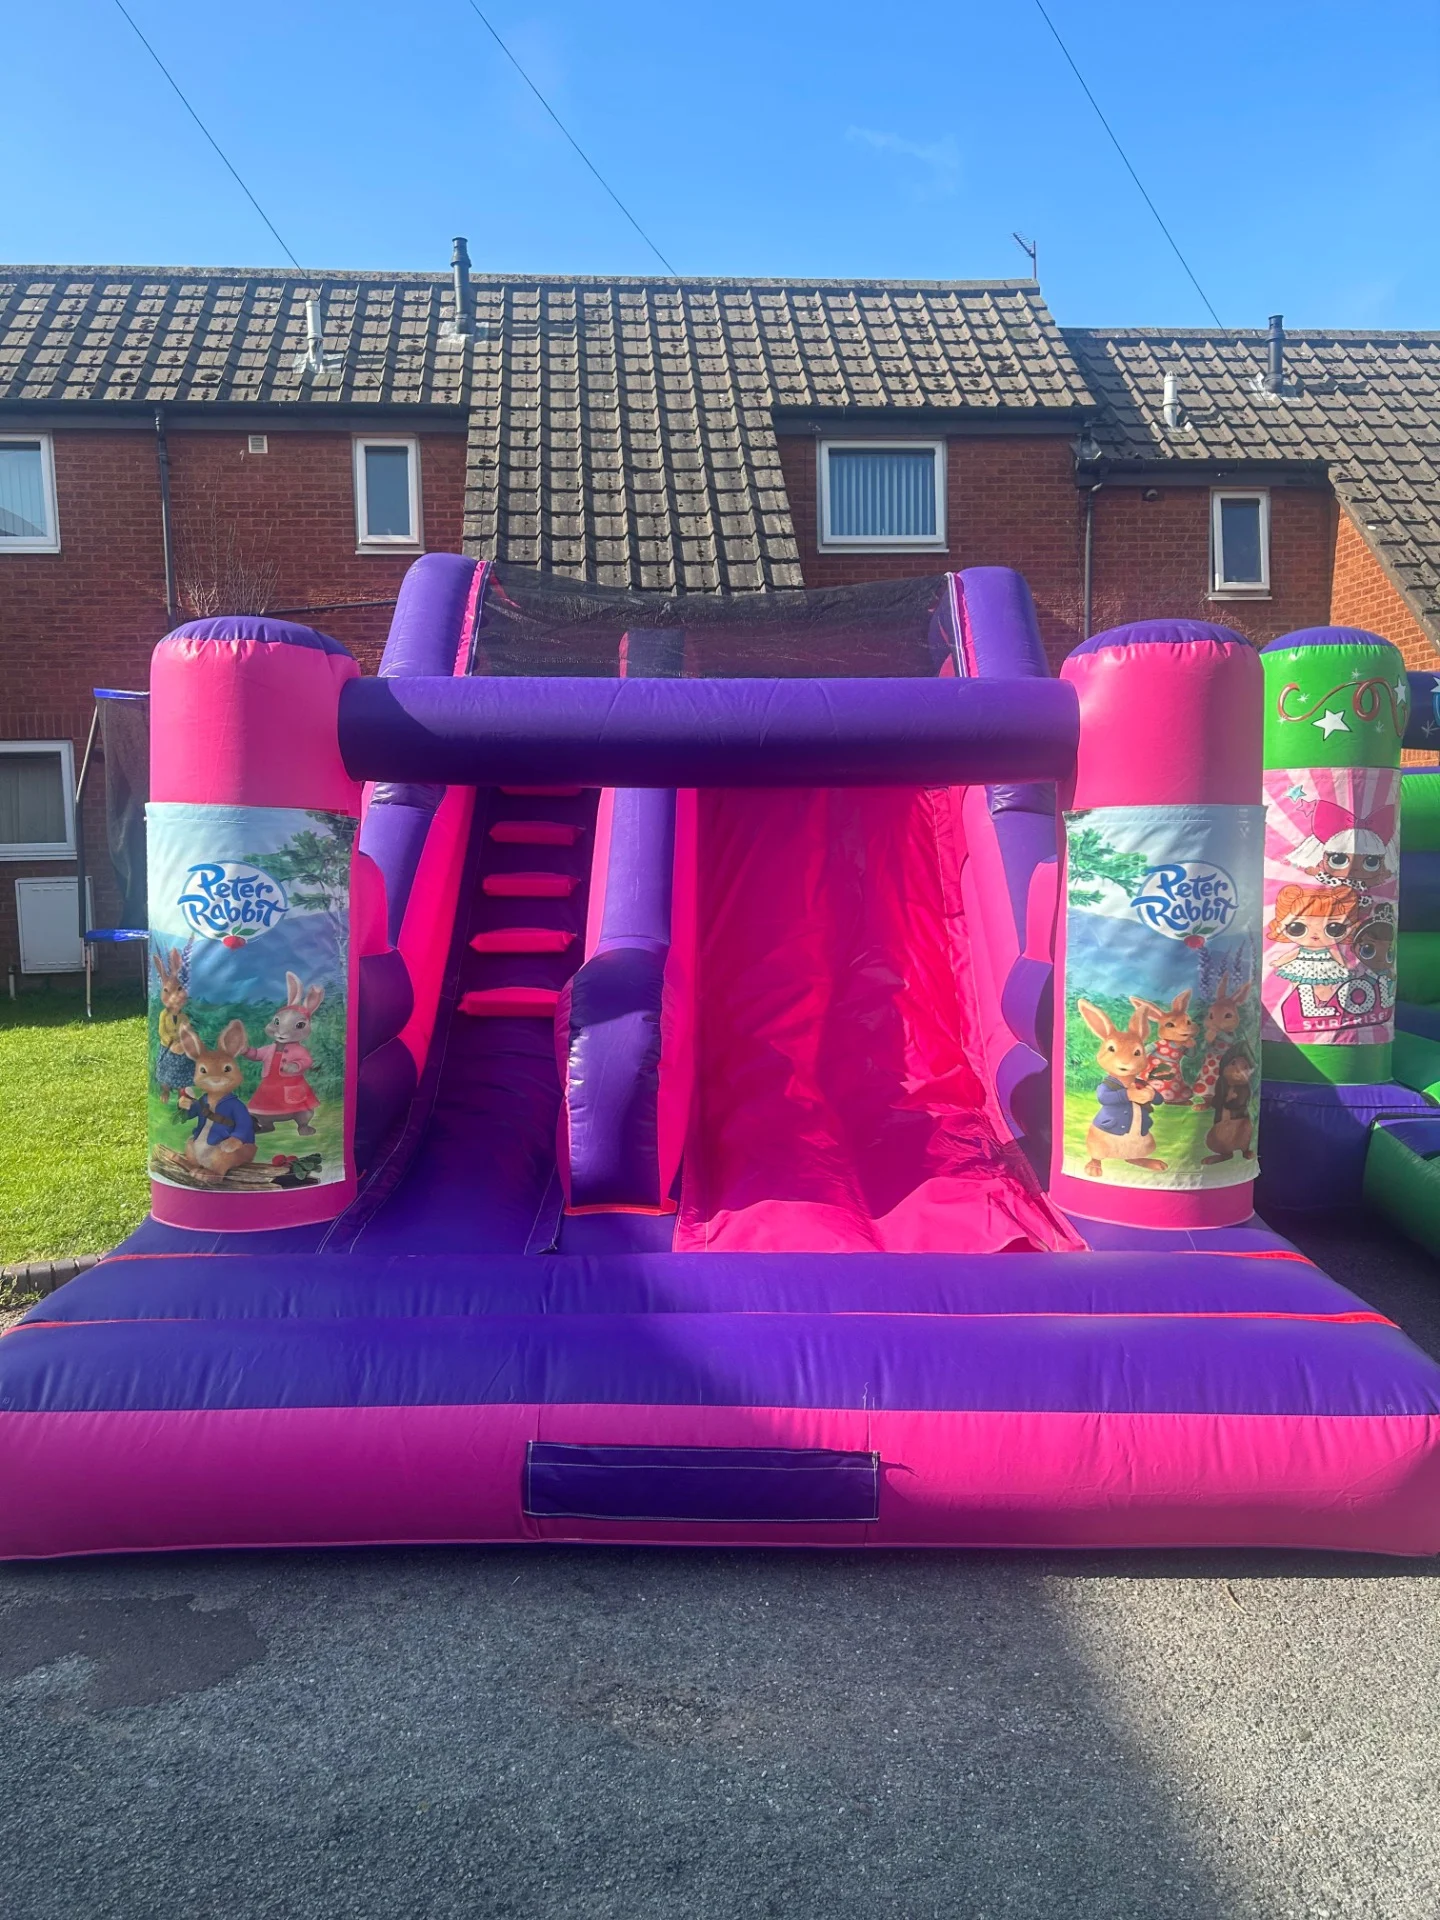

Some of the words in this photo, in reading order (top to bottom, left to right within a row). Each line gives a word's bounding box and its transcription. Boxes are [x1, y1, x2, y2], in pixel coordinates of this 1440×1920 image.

[187, 863, 273, 901] Peter
[1145, 864, 1228, 901] Peter
[177, 894, 289, 931] Rabbit
[1130, 895, 1239, 931] Rabbit
